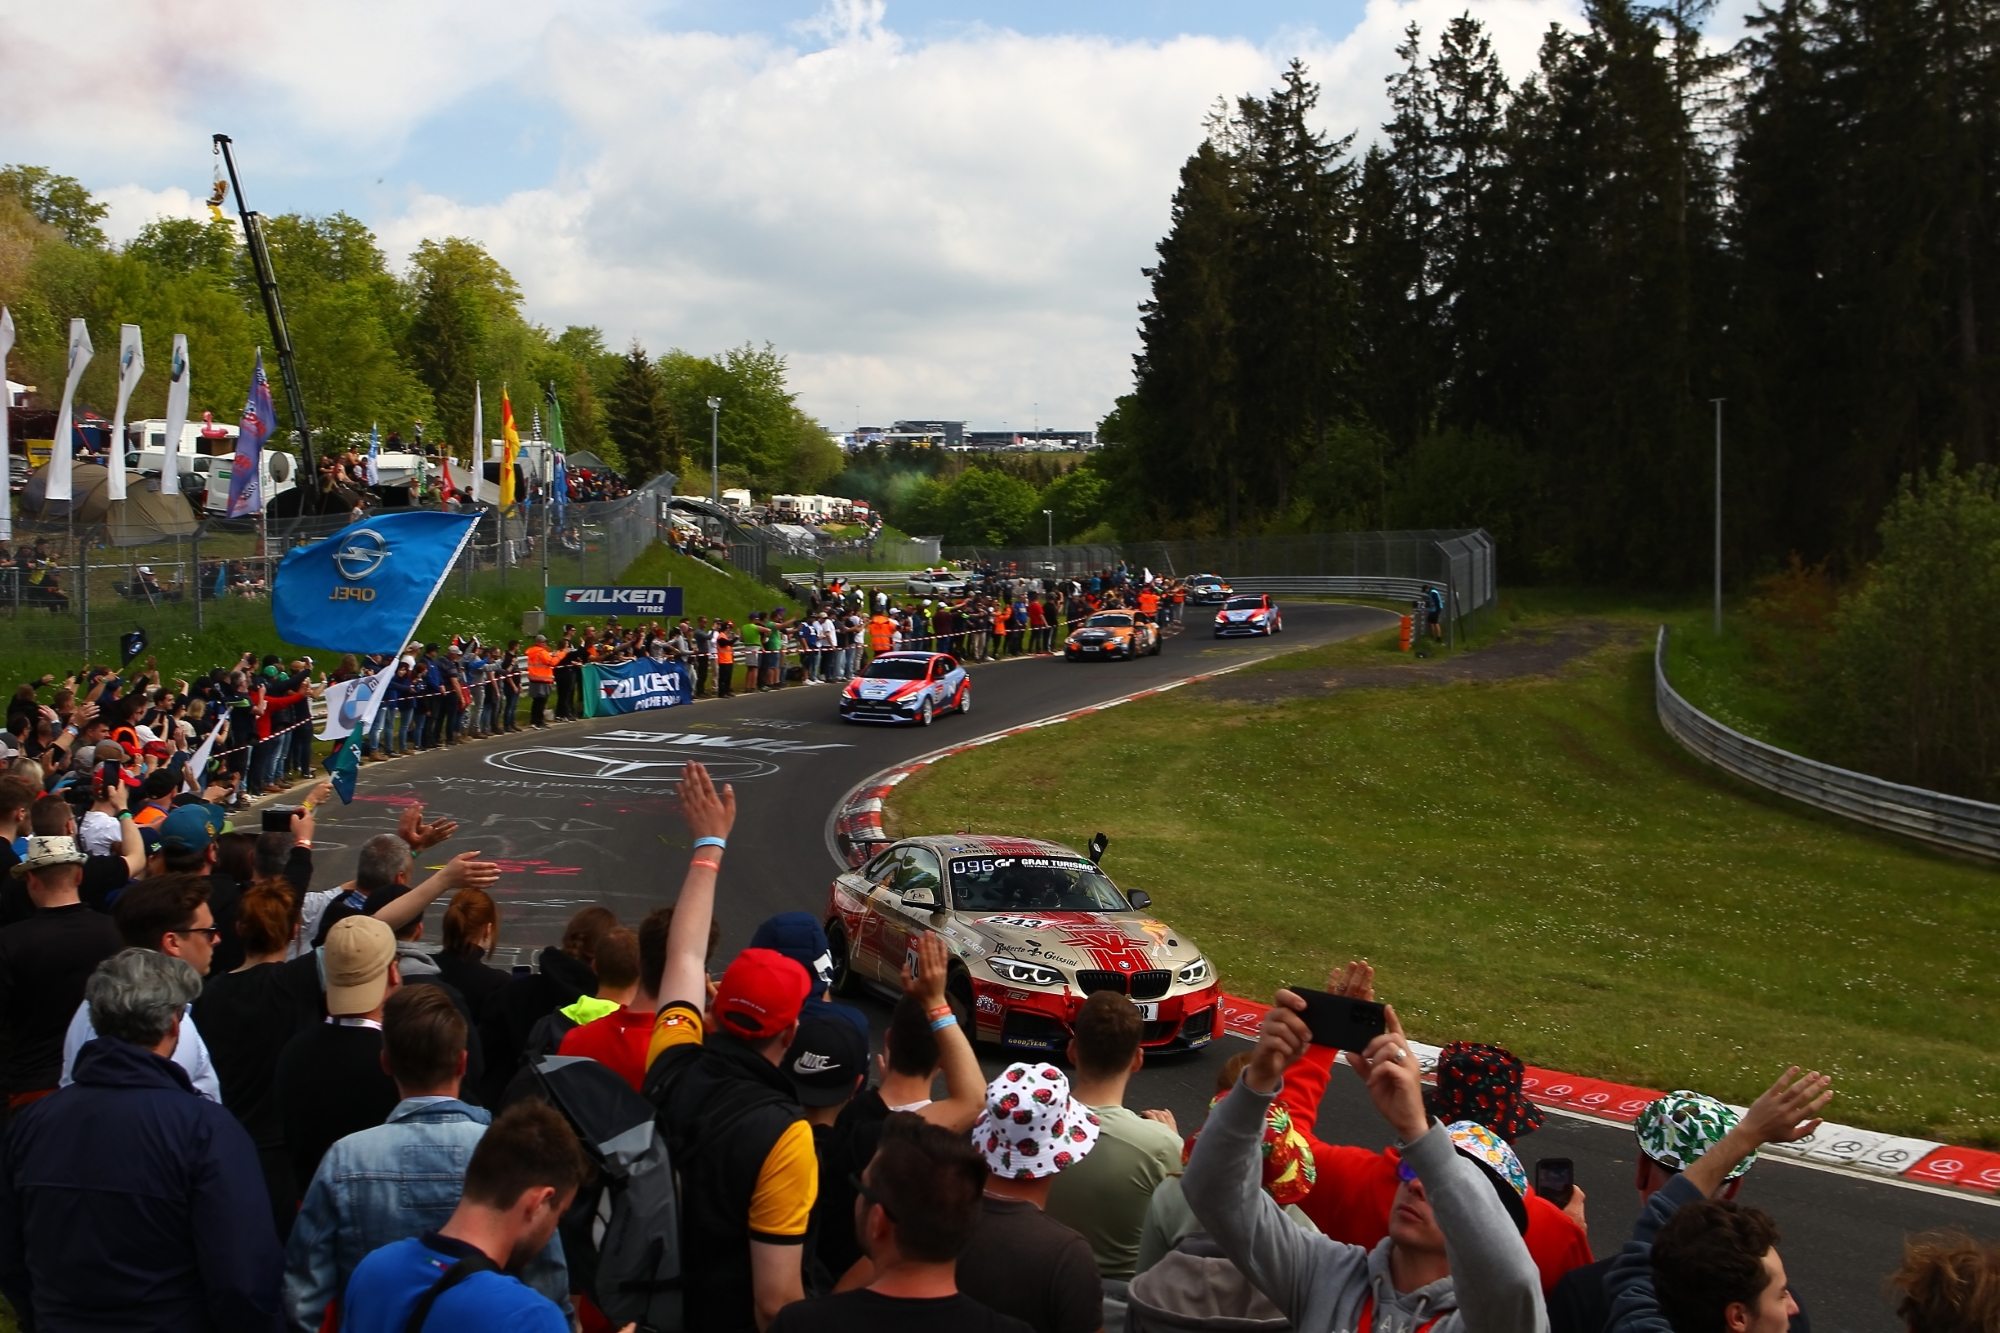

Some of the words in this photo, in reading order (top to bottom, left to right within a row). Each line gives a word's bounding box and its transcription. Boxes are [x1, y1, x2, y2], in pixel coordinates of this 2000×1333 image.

[564, 589, 667, 604] FALKEN
[636, 605, 664, 613] TYRES
[600, 672, 680, 699] FALKEN
[953, 859, 995, 874] 096
[1021, 858, 1049, 866] GRAN
[1051, 859, 1095, 871] TURISMO
[990, 916, 1043, 929] 243
[800, 1051, 830, 1068] NIKE
